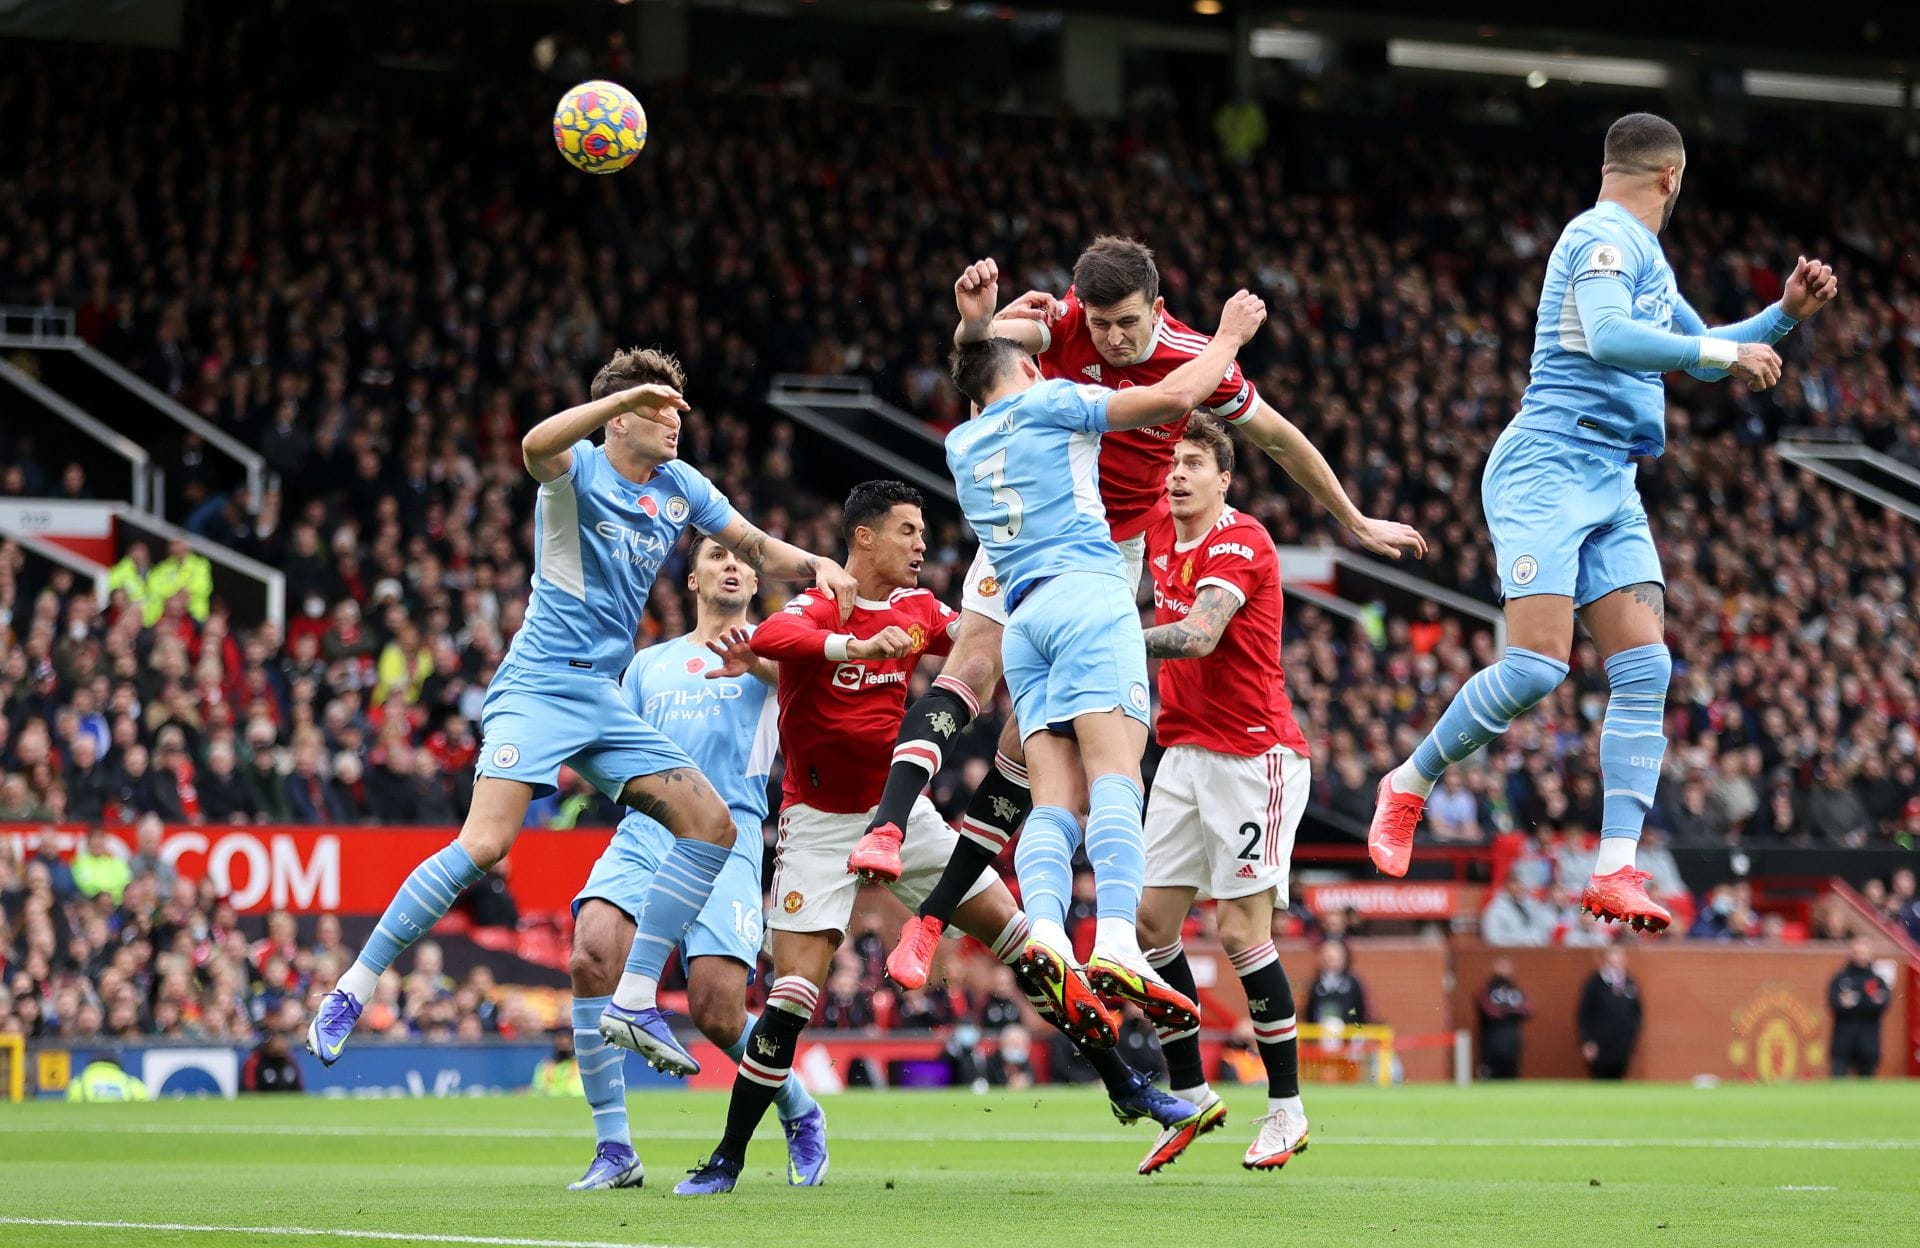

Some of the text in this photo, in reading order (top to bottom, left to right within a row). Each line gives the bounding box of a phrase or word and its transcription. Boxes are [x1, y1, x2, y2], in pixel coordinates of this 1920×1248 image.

[973, 447, 1024, 544] 3
[595, 520, 675, 557] ETIHA
[1208, 542, 1254, 562] KOHLER
[611, 547, 661, 571] AIWAY
[645, 683, 743, 714] ETIHAD
[1237, 821, 1262, 861] 2
[398, 912, 426, 935] CITY
[731, 899, 760, 943] 16
